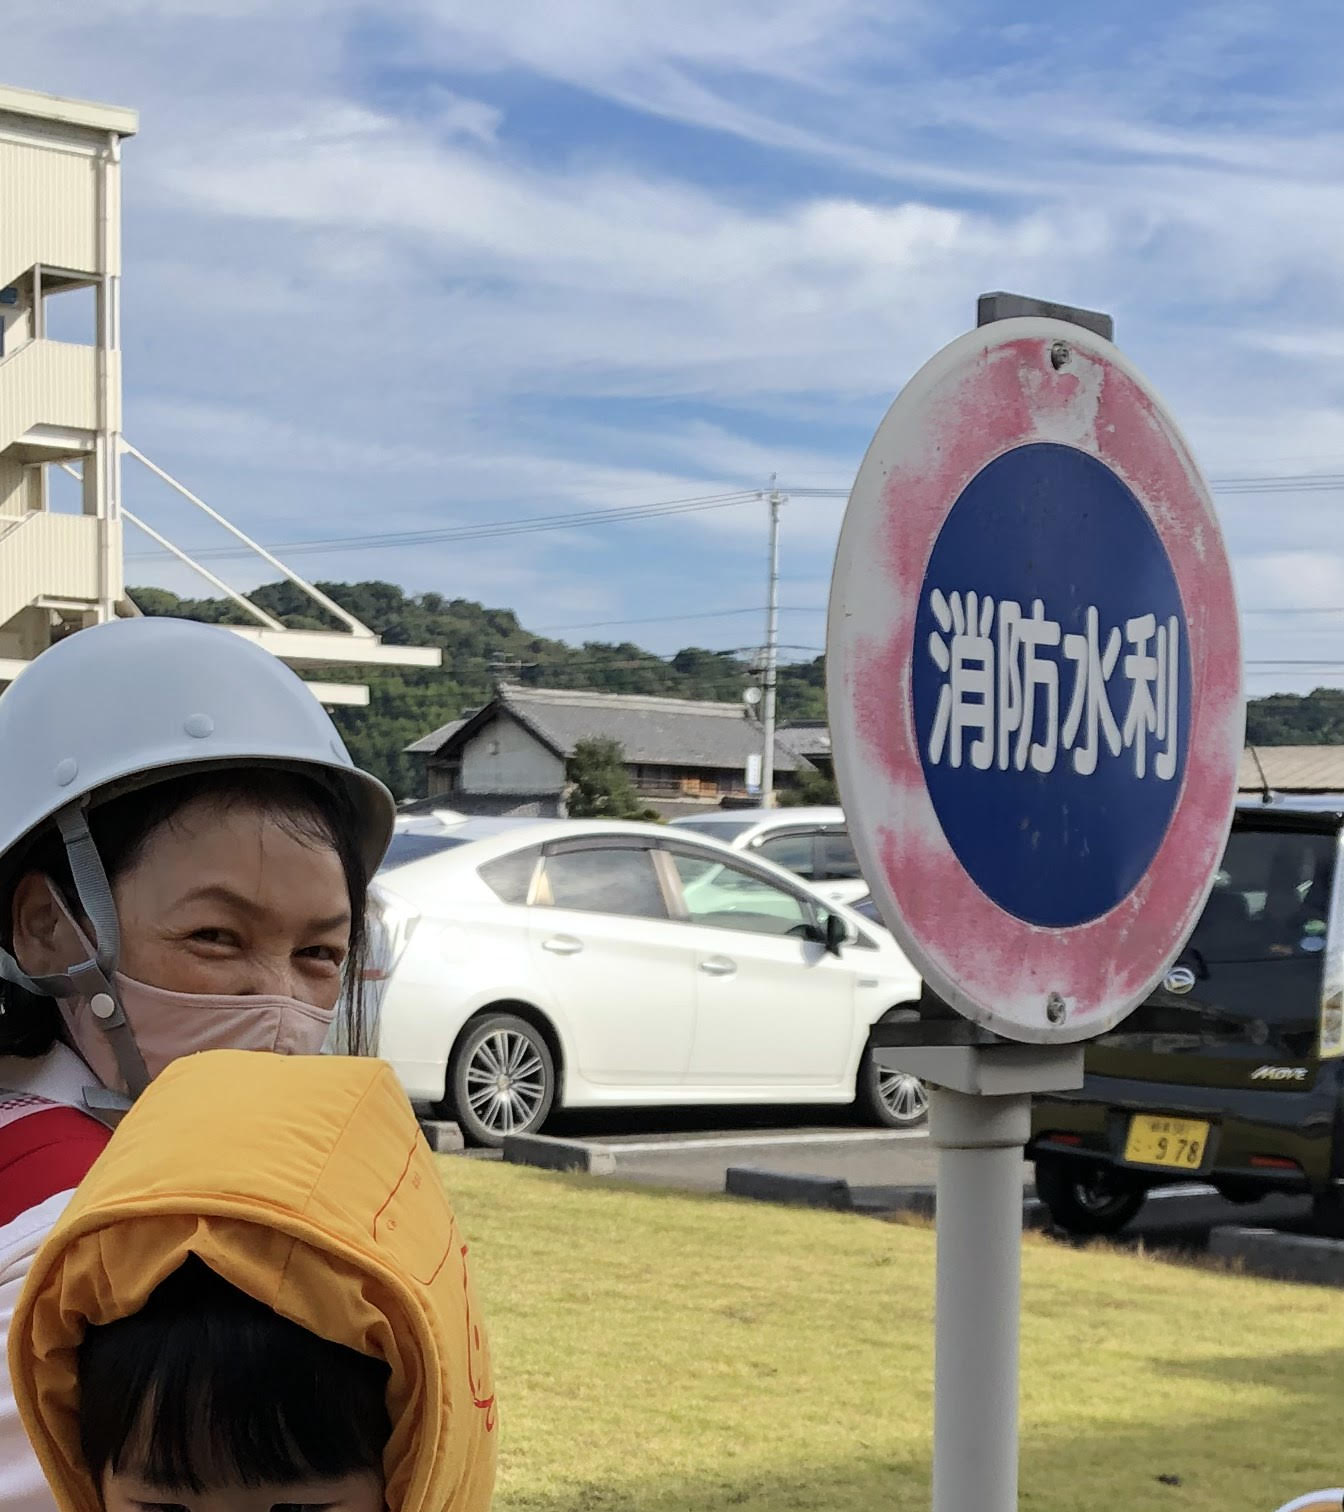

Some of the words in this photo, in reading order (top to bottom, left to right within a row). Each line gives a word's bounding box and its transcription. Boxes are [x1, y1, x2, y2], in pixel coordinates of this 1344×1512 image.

[928, 589, 1180, 781] 消防水利
[1251, 1065, 1308, 1081] MOVE
